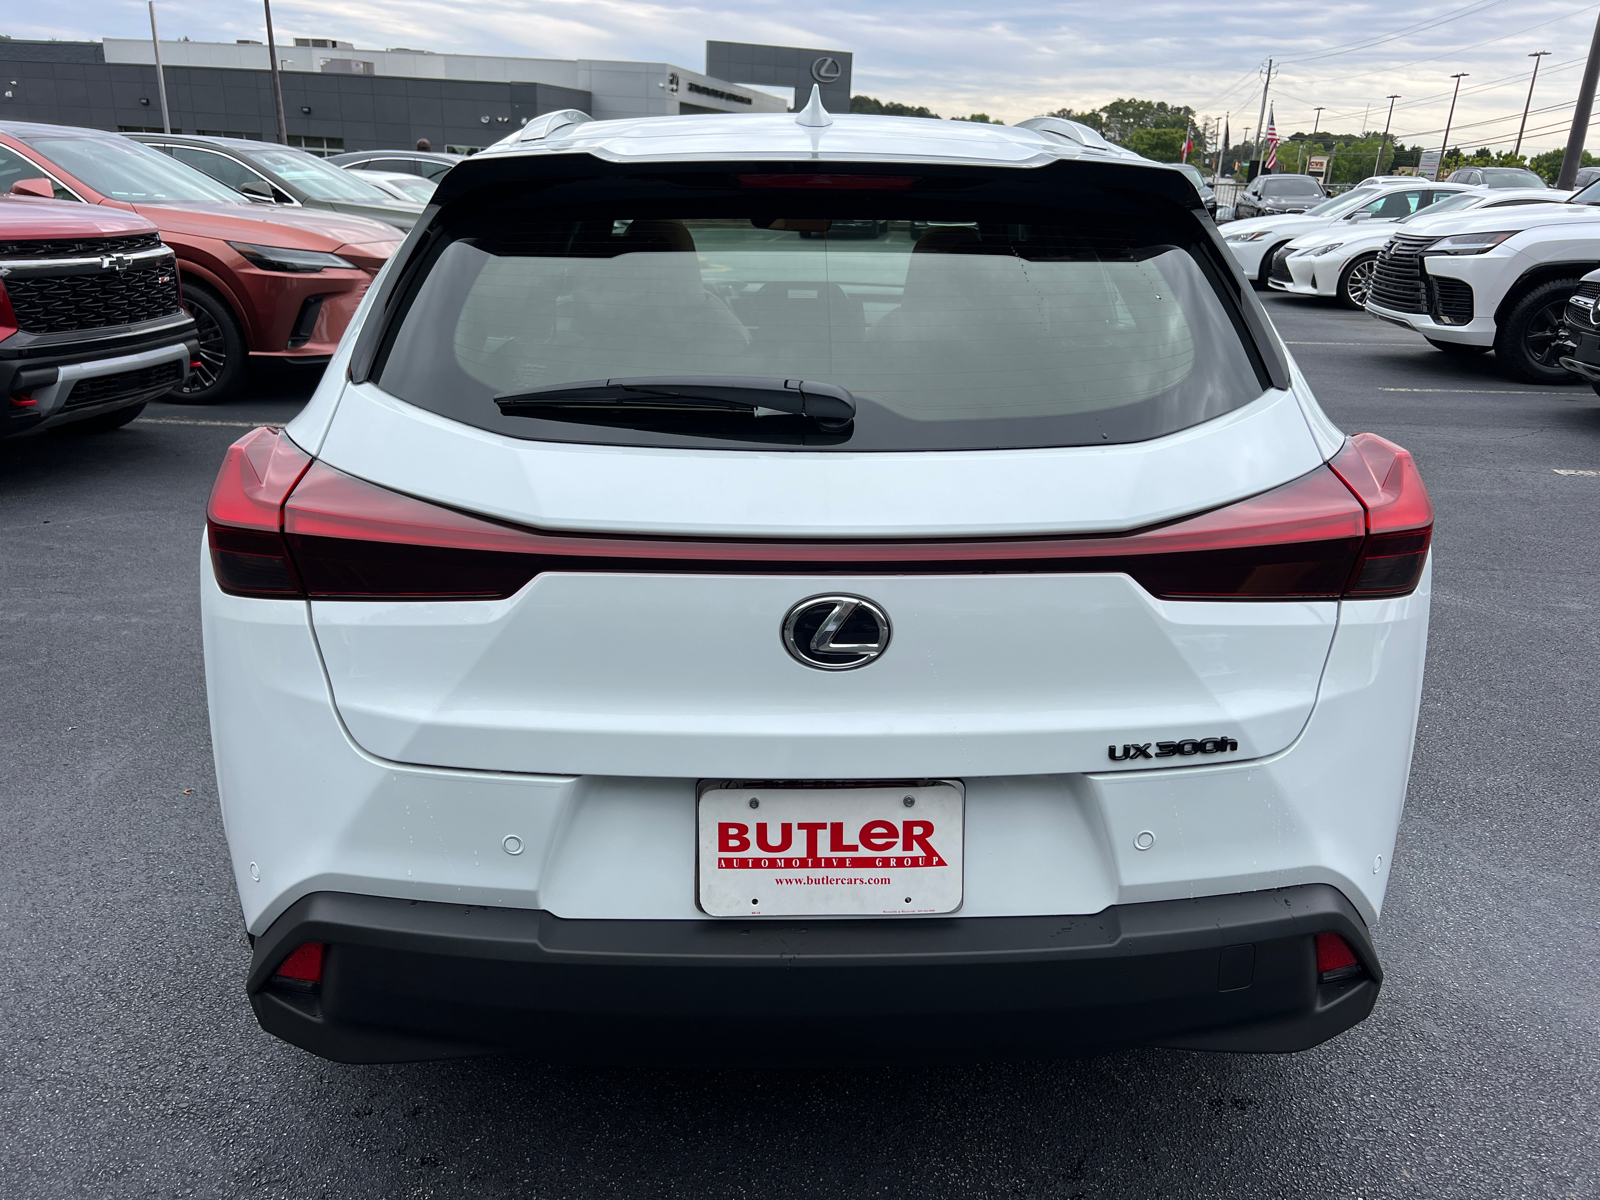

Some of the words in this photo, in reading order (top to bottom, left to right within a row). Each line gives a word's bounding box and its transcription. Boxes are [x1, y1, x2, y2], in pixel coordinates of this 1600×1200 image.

[1108, 743, 1153, 761] UX
[1155, 736, 1238, 757] 300h
[719, 857, 853, 868] AUTOMOTIVE
[875, 856, 940, 867] GROUP
[774, 875, 892, 886] www.butlercars.com
